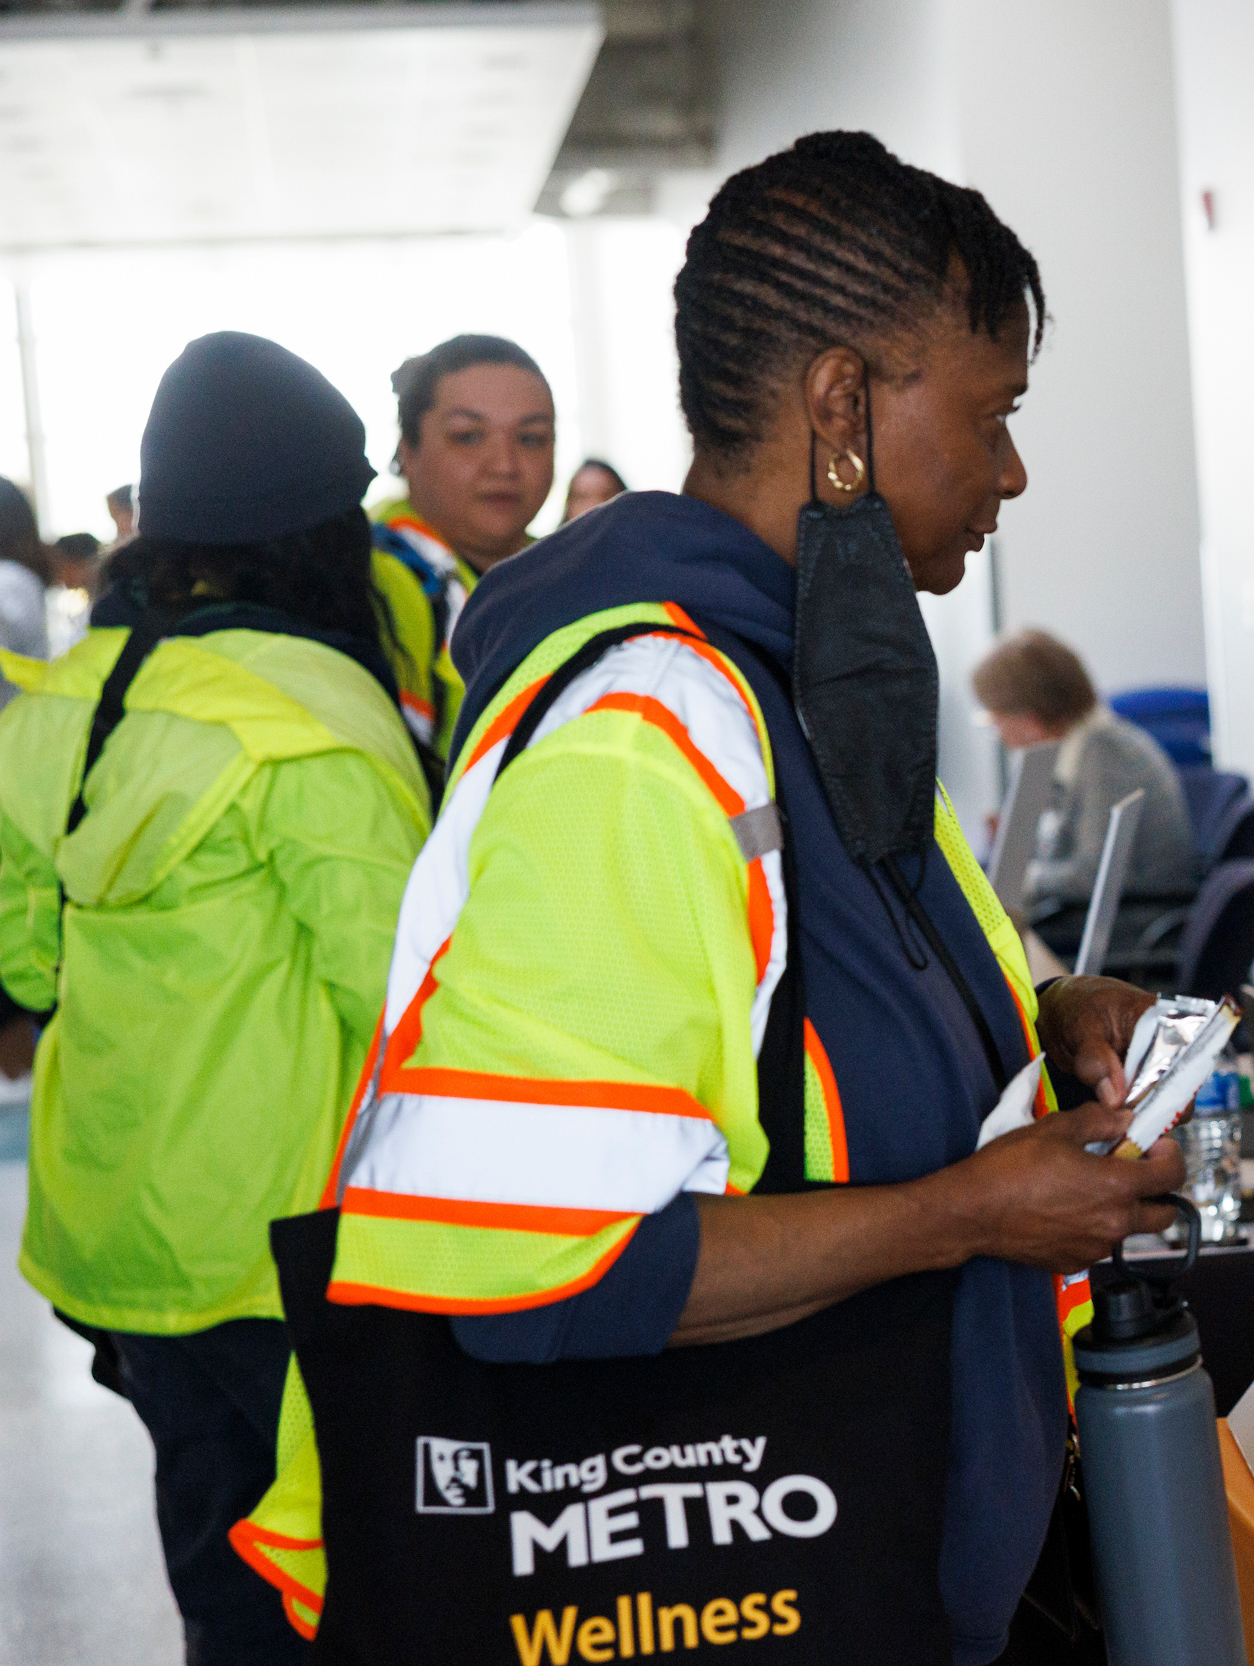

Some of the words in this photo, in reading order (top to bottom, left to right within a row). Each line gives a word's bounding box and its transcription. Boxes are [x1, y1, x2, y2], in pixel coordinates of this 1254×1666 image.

[505, 1453, 607, 1494] King
[611, 1434, 768, 1474] County
[509, 1474, 837, 1577] METRO
[509, 1589, 802, 1666] Wellness
